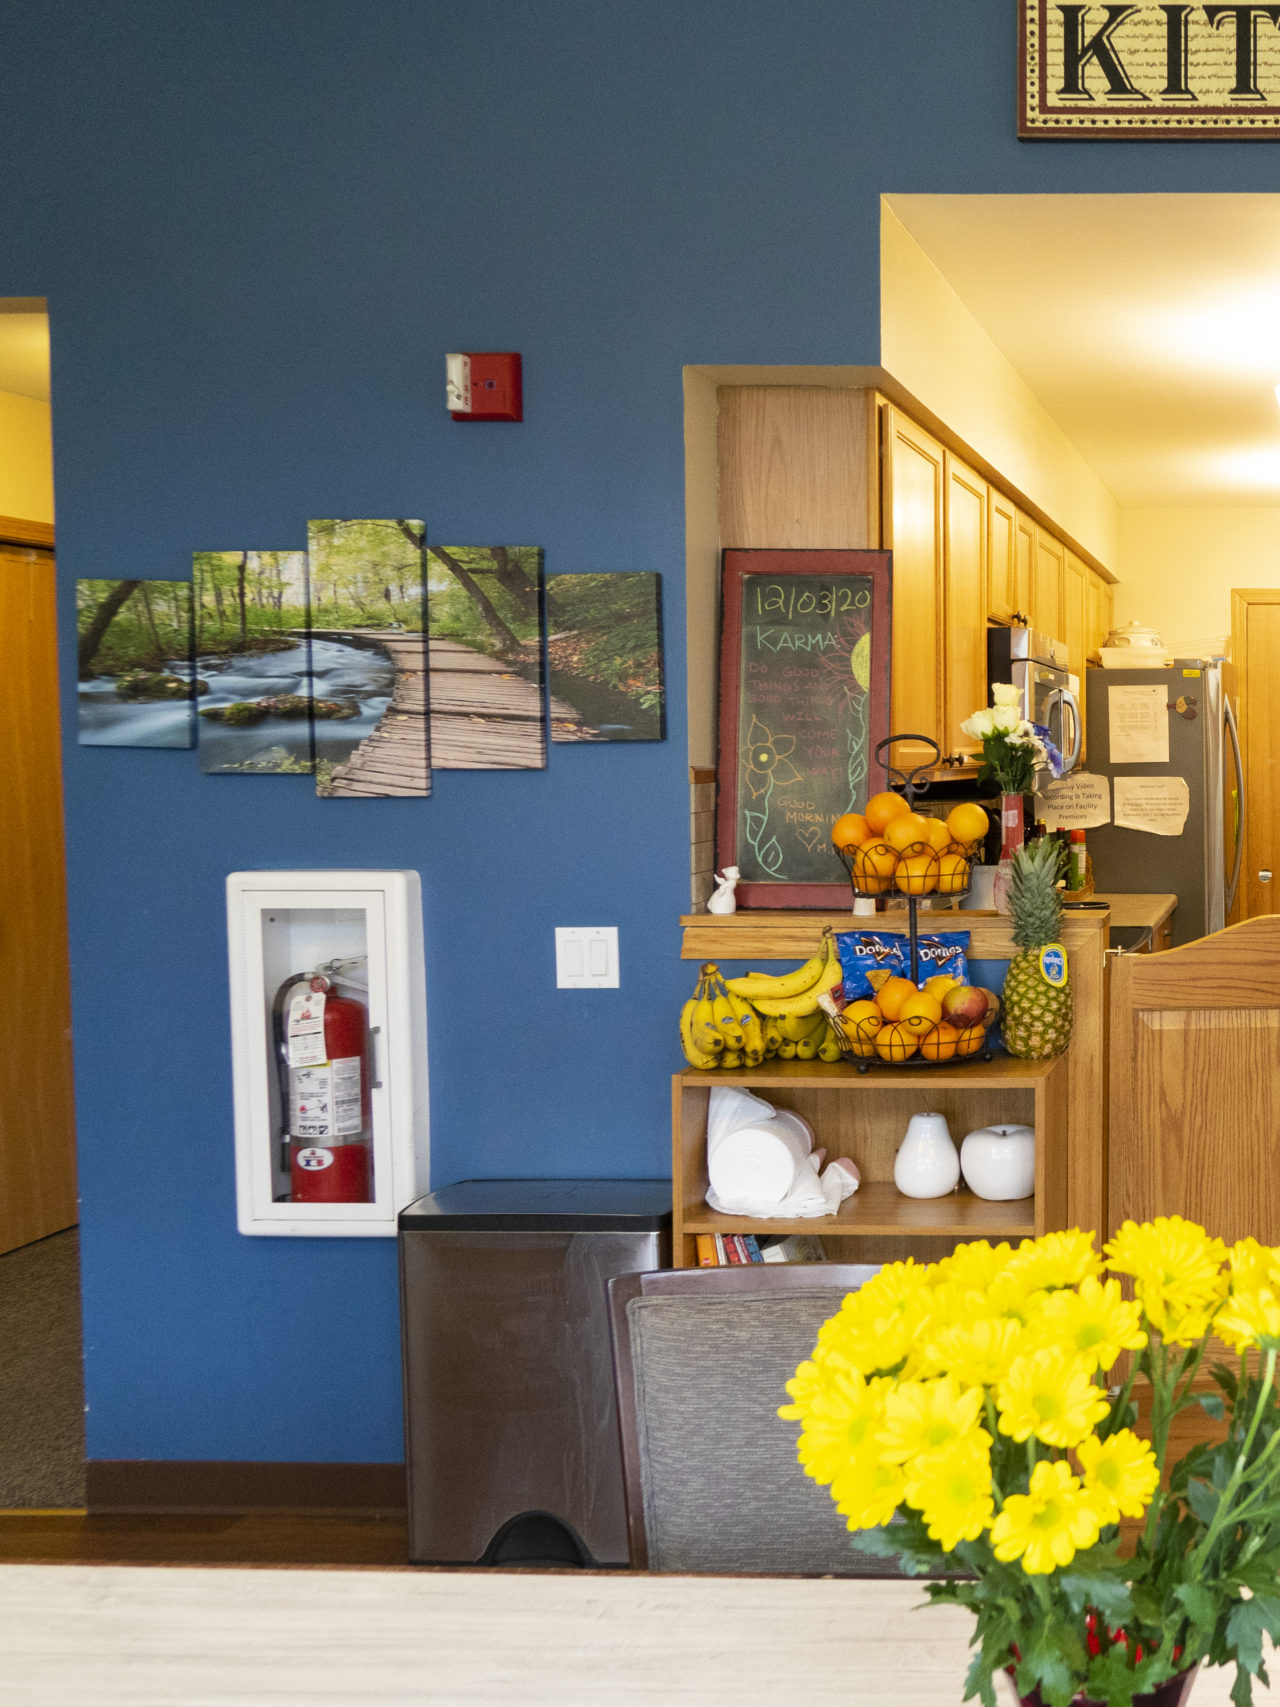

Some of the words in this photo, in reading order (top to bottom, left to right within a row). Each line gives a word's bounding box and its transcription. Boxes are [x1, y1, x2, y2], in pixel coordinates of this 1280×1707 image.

[757, 585, 871, 620] 12/03/20
[783, 665, 820, 678] GOOD
[782, 711, 822, 721] WILL
[798, 728, 838, 740] COME
[776, 795, 817, 810] GOOD
[786, 811, 841, 824] MORNIN
